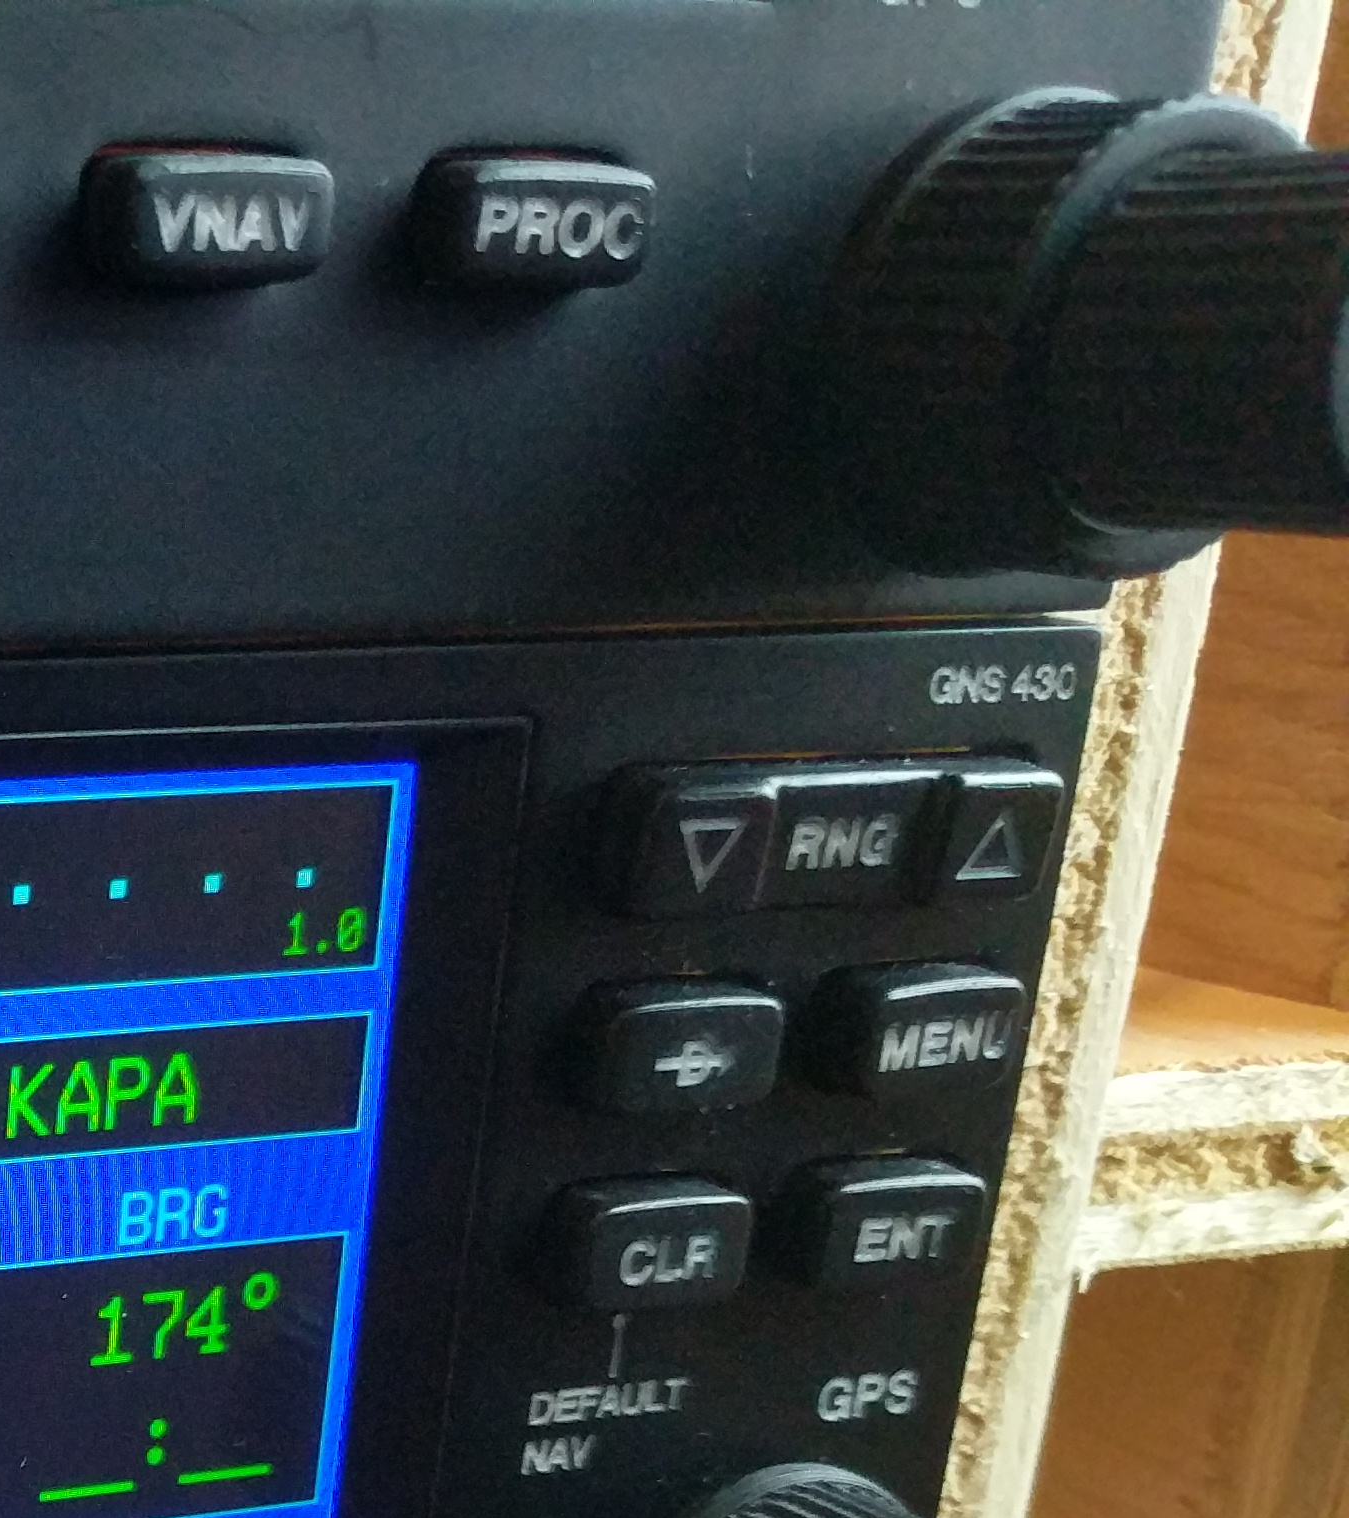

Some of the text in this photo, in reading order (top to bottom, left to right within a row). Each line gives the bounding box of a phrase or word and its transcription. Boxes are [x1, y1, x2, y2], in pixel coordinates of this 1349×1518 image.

[150, 191, 312, 256] VNAV
[471, 193, 643, 261] PROC
[928, 661, 1078, 706] GNS 430
[785, 813, 901, 872] RNG
[281, 905, 369, 958] 1.0
[878, 1015, 1008, 1073] MENU
[4, 1052, 201, 1141] KAPA
[118, 1184, 230, 1248] BRG
[852, 1212, 955, 1265] ENT
[618, 1234, 716, 1289] CLR
[89, 1271, 279, 1369] 174°
[526, 1375, 692, 1427] DEFAULT
[816, 1369, 921, 1423] GPS
[520, 1436, 598, 1476] NAV
